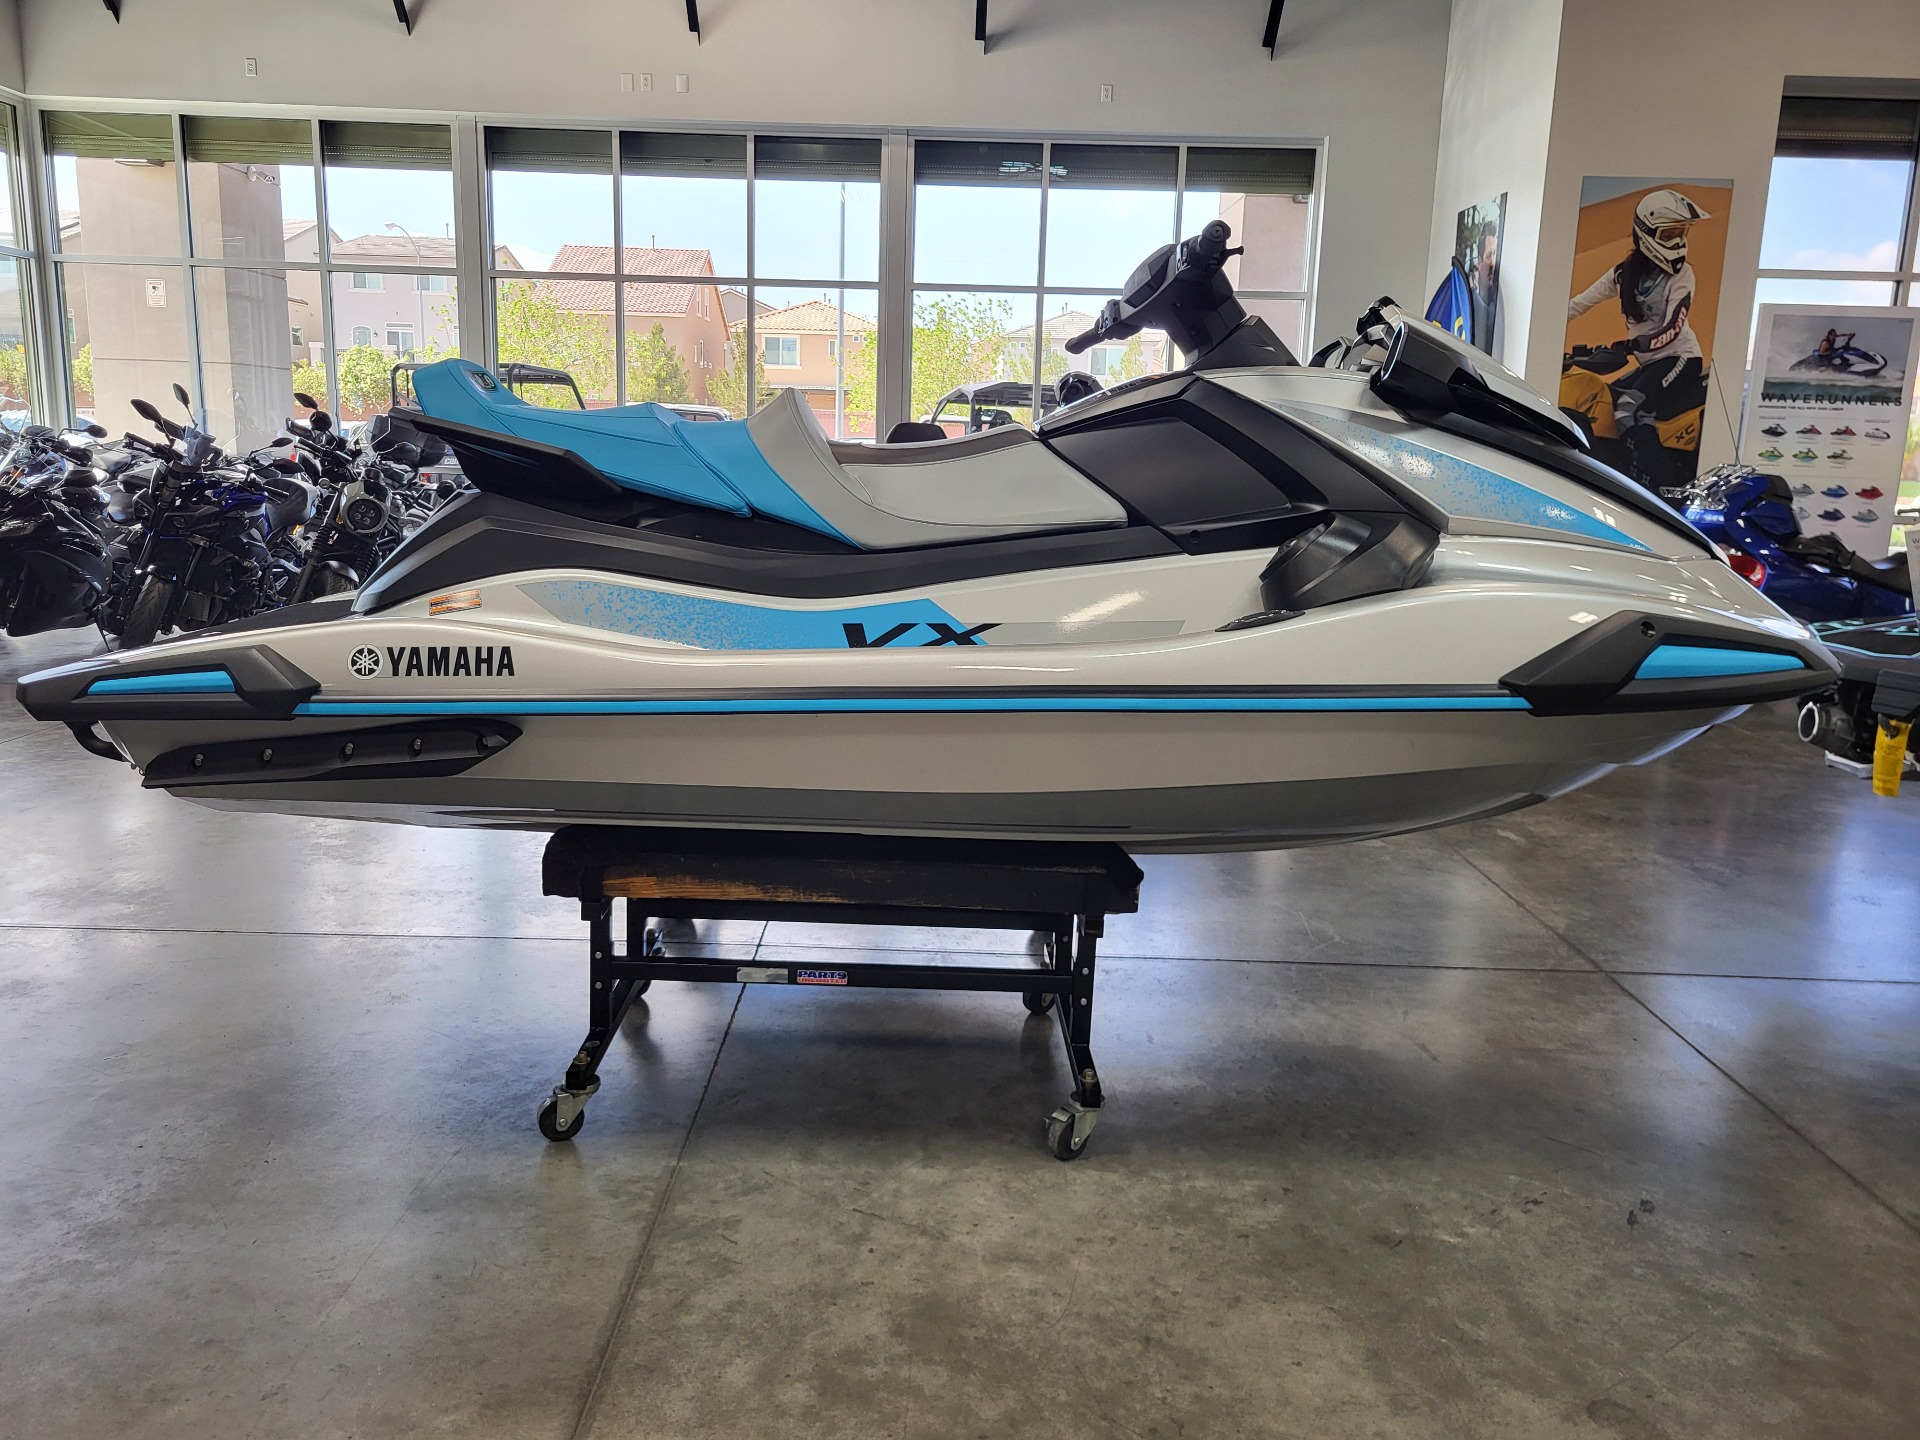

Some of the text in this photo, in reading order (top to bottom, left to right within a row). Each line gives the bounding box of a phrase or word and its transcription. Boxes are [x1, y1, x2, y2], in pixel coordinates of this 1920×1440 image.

[1761, 392, 1902, 406] WAVERUNNERS
[842, 622, 1004, 649] VX
[387, 646, 515, 677] YAMAHA
[798, 970, 847, 979] PARTS
